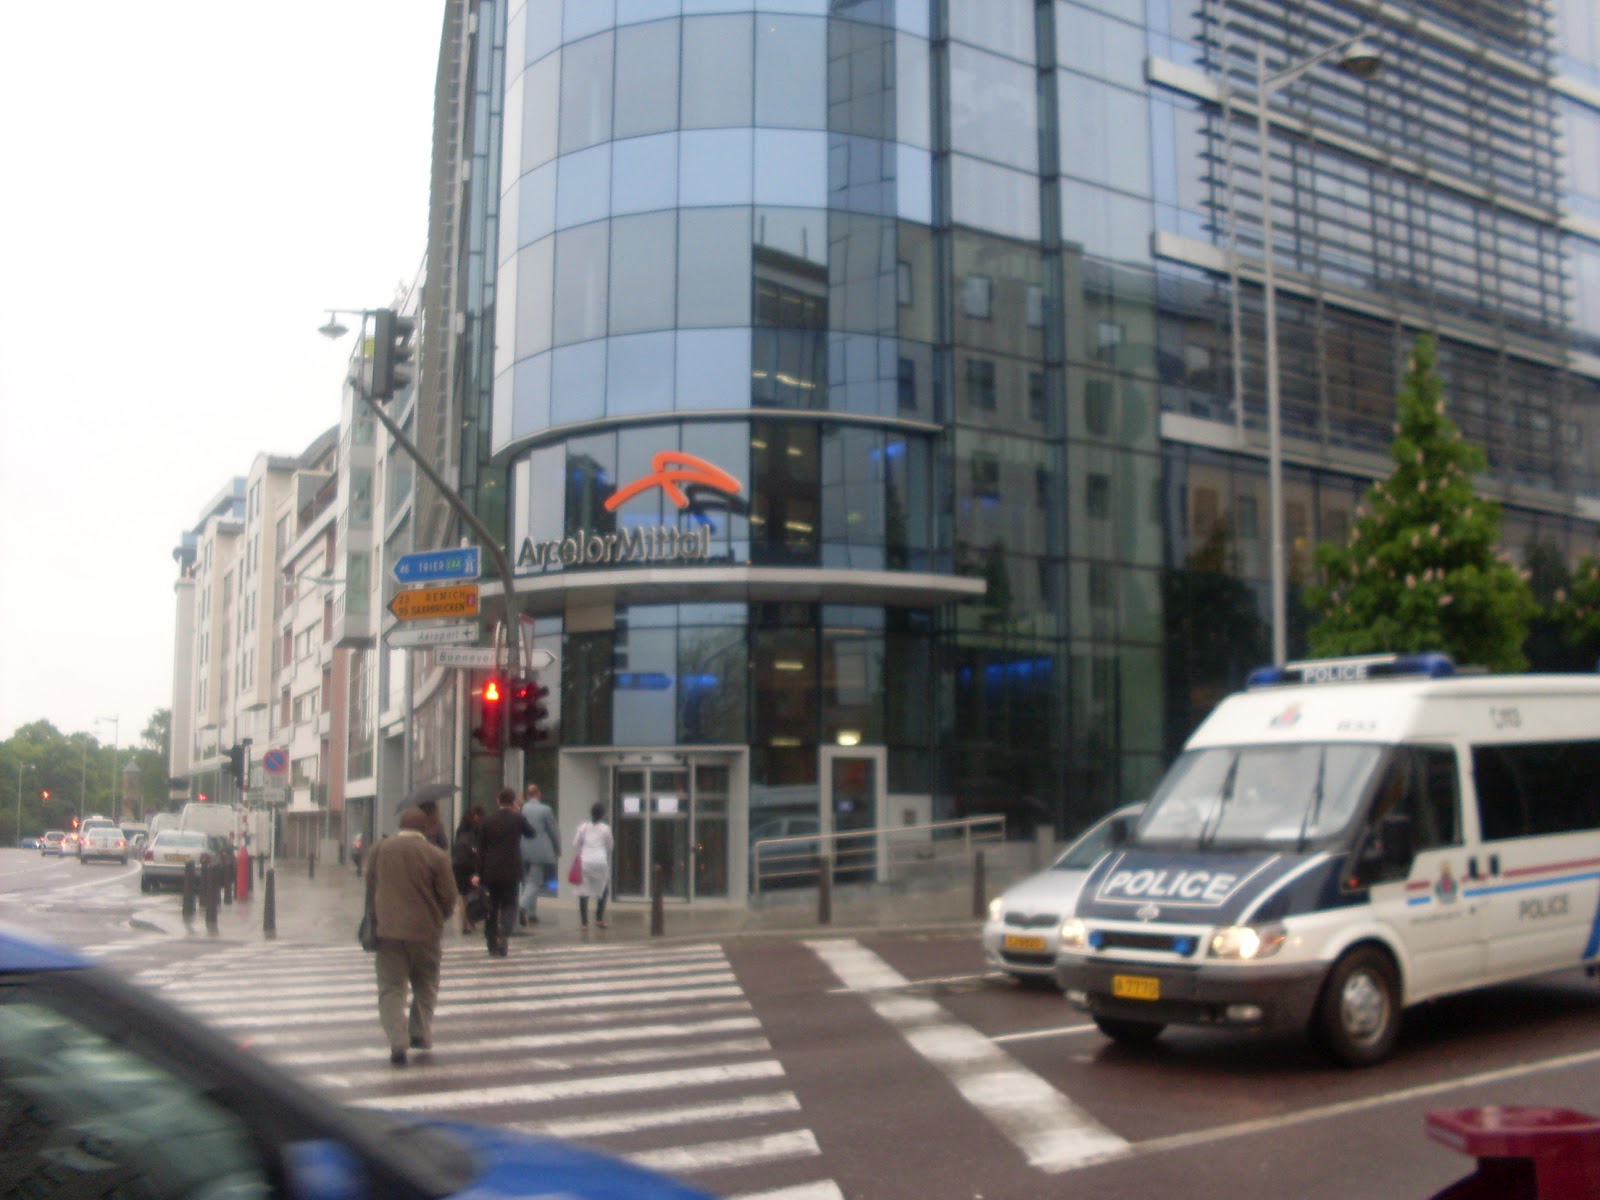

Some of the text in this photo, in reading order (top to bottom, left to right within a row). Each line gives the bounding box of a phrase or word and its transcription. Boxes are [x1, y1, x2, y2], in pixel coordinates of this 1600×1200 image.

[518, 523, 710, 567] ArcelorMittal
[419, 559, 444, 573] TRIER
[426, 590, 465, 603] REMICH
[1303, 664, 1367, 683] POLICE
[1104, 869, 1237, 900] POLICE
[1519, 893, 1569, 922] POLICE
